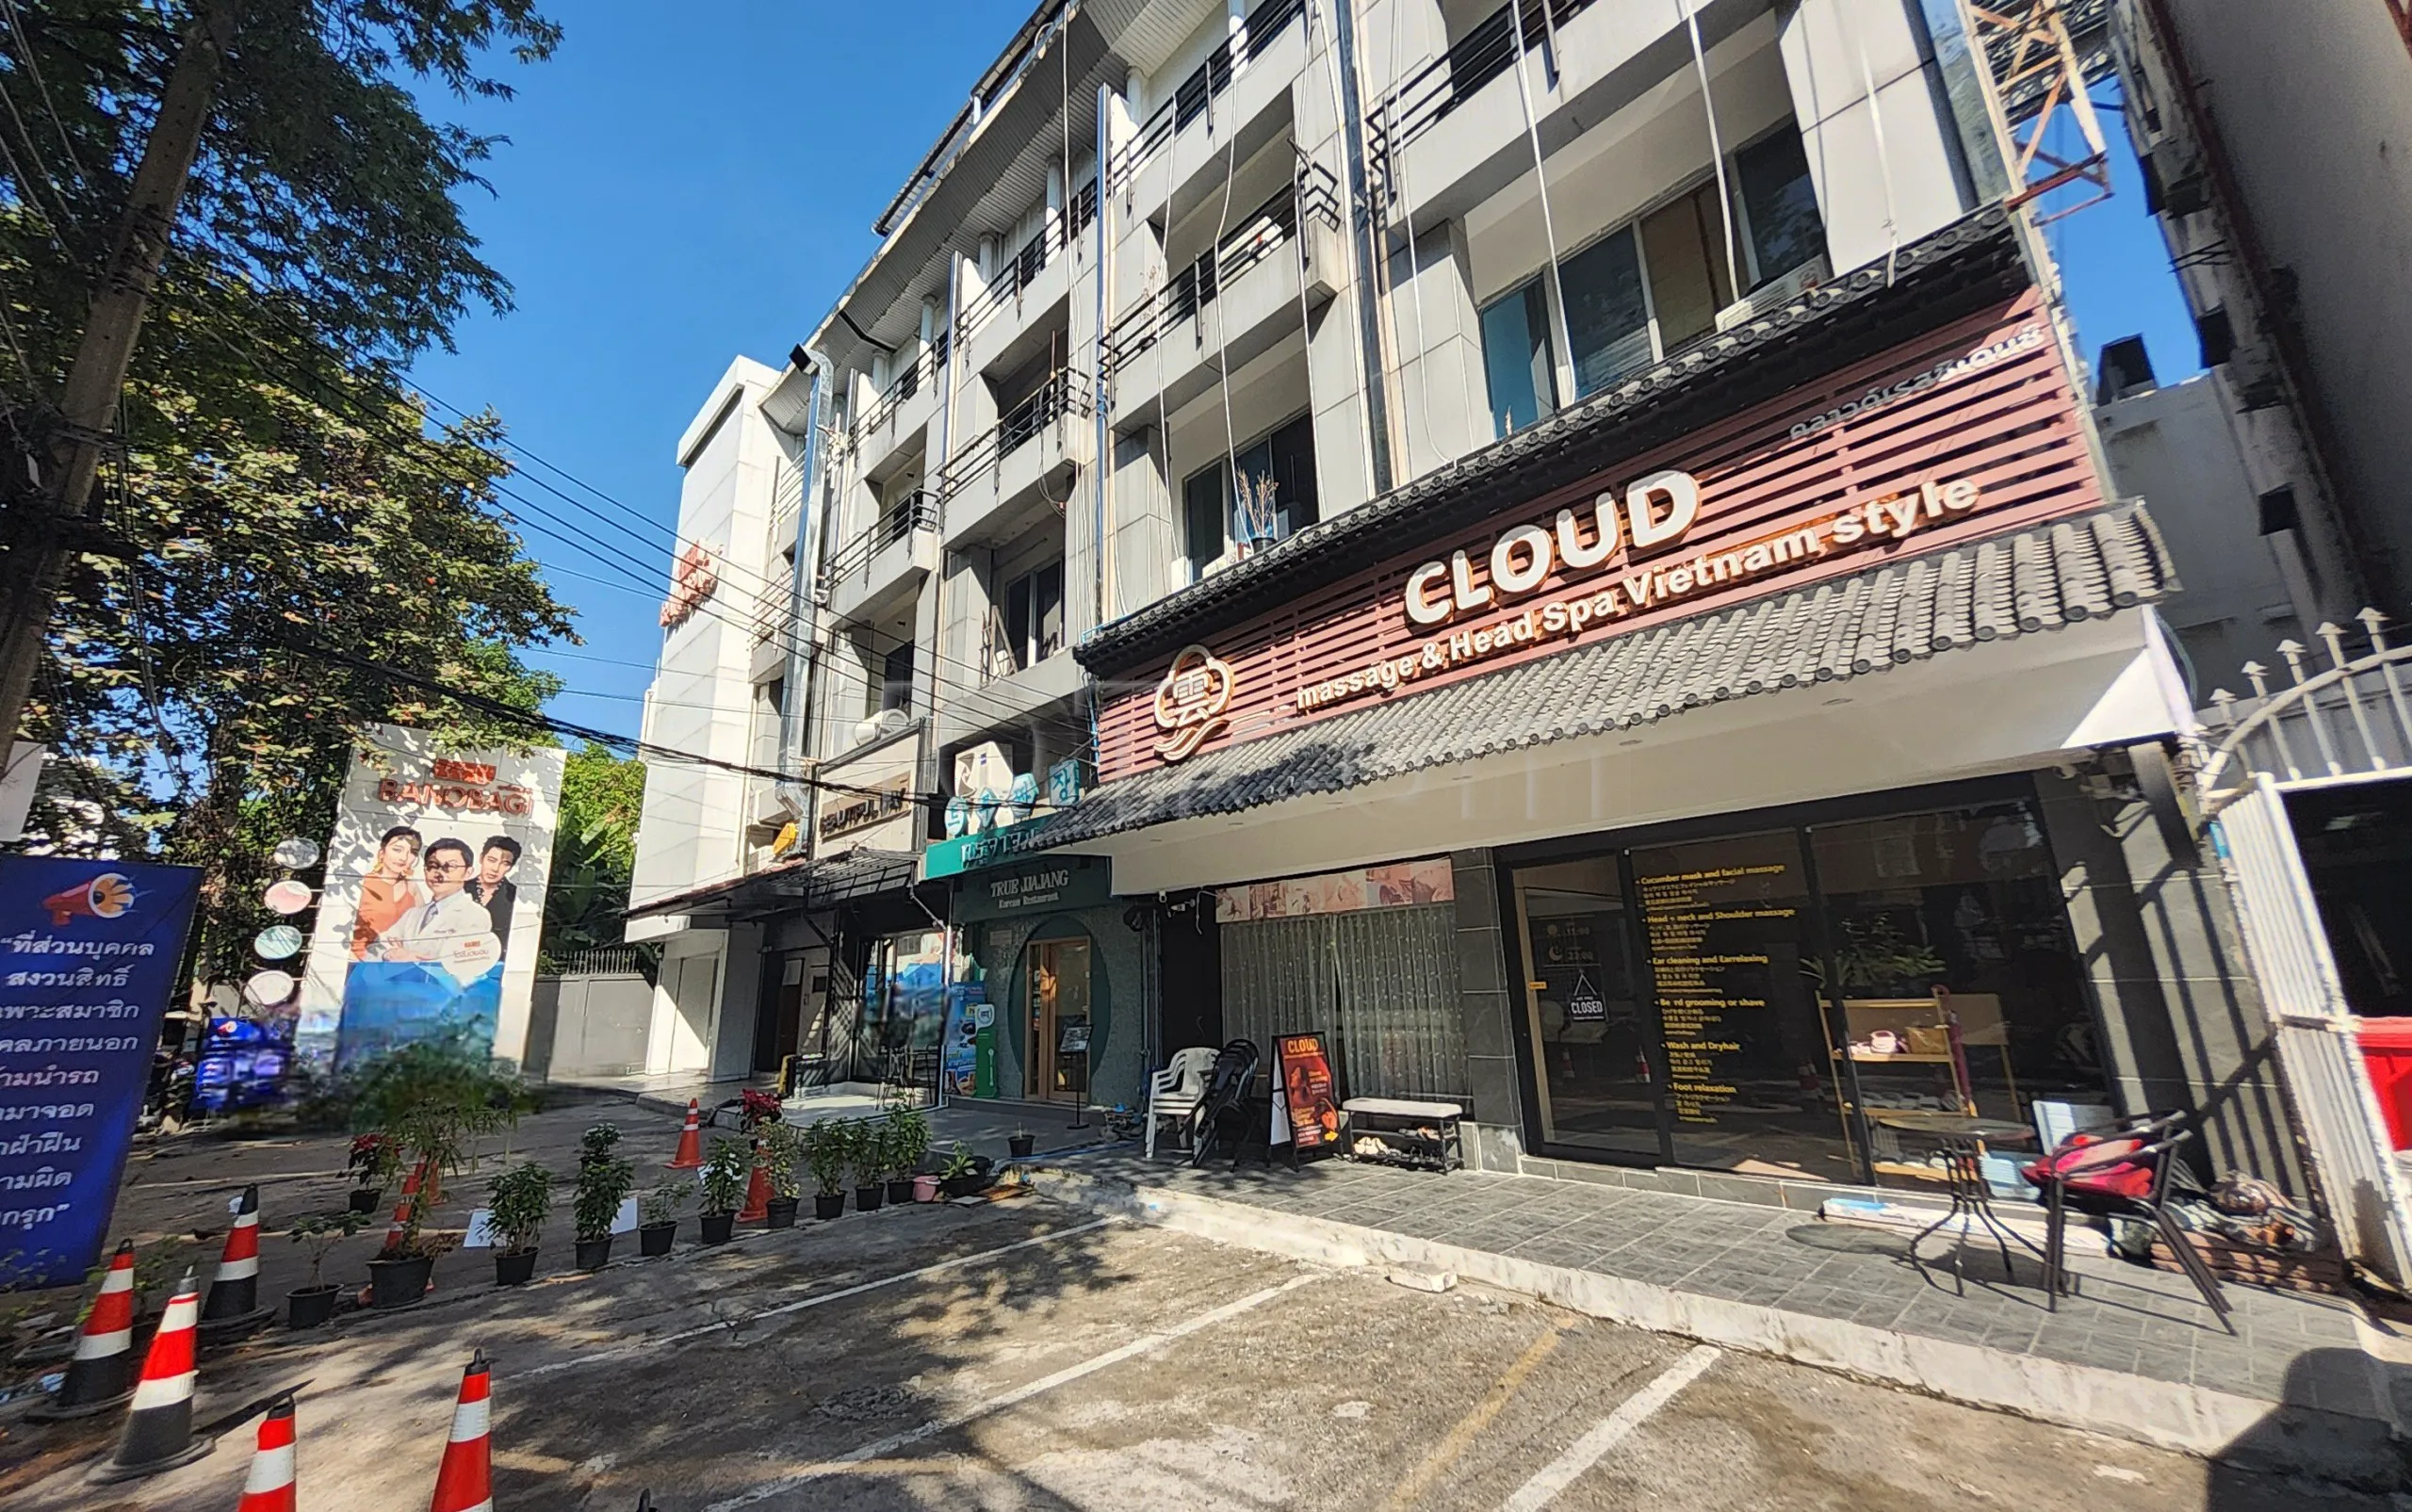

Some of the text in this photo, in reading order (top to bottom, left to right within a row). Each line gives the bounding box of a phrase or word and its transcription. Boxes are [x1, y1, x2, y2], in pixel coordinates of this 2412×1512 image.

[1405, 469, 1701, 625] CLOUD
[1296, 477, 1979, 709] massage & Head Spa Vietnam style
[379, 778, 533, 819] BANOBAGI
[1641, 864, 1785, 885] Cucumber mask and facial massage
[990, 878, 1019, 898] TRUE
[1647, 915, 1668, 923] Head
[1677, 912, 1696, 921] neck
[1698, 911, 1714, 920] and
[1715, 909, 1752, 919] Shoulder
[1754, 908, 1795, 919] massage
[1667, 955, 1701, 966] cleaning
[1702, 955, 1718, 964] and
[8, 964, 135, 986] สงวนสิทธิ์
[0, 999, 139, 1020] พาะสมาชิก
[1571, 1000, 1603, 1014] CLOSED
[1685, 999, 1726, 1009] grooming
[1738, 998, 1765, 1007] shave
[1287, 1037, 1318, 1053] CLOUD
[1666, 1041, 1689, 1049] Wash
[1691, 1041, 1706, 1050] and
[1673, 1082, 1737, 1094] Foot relaxation
